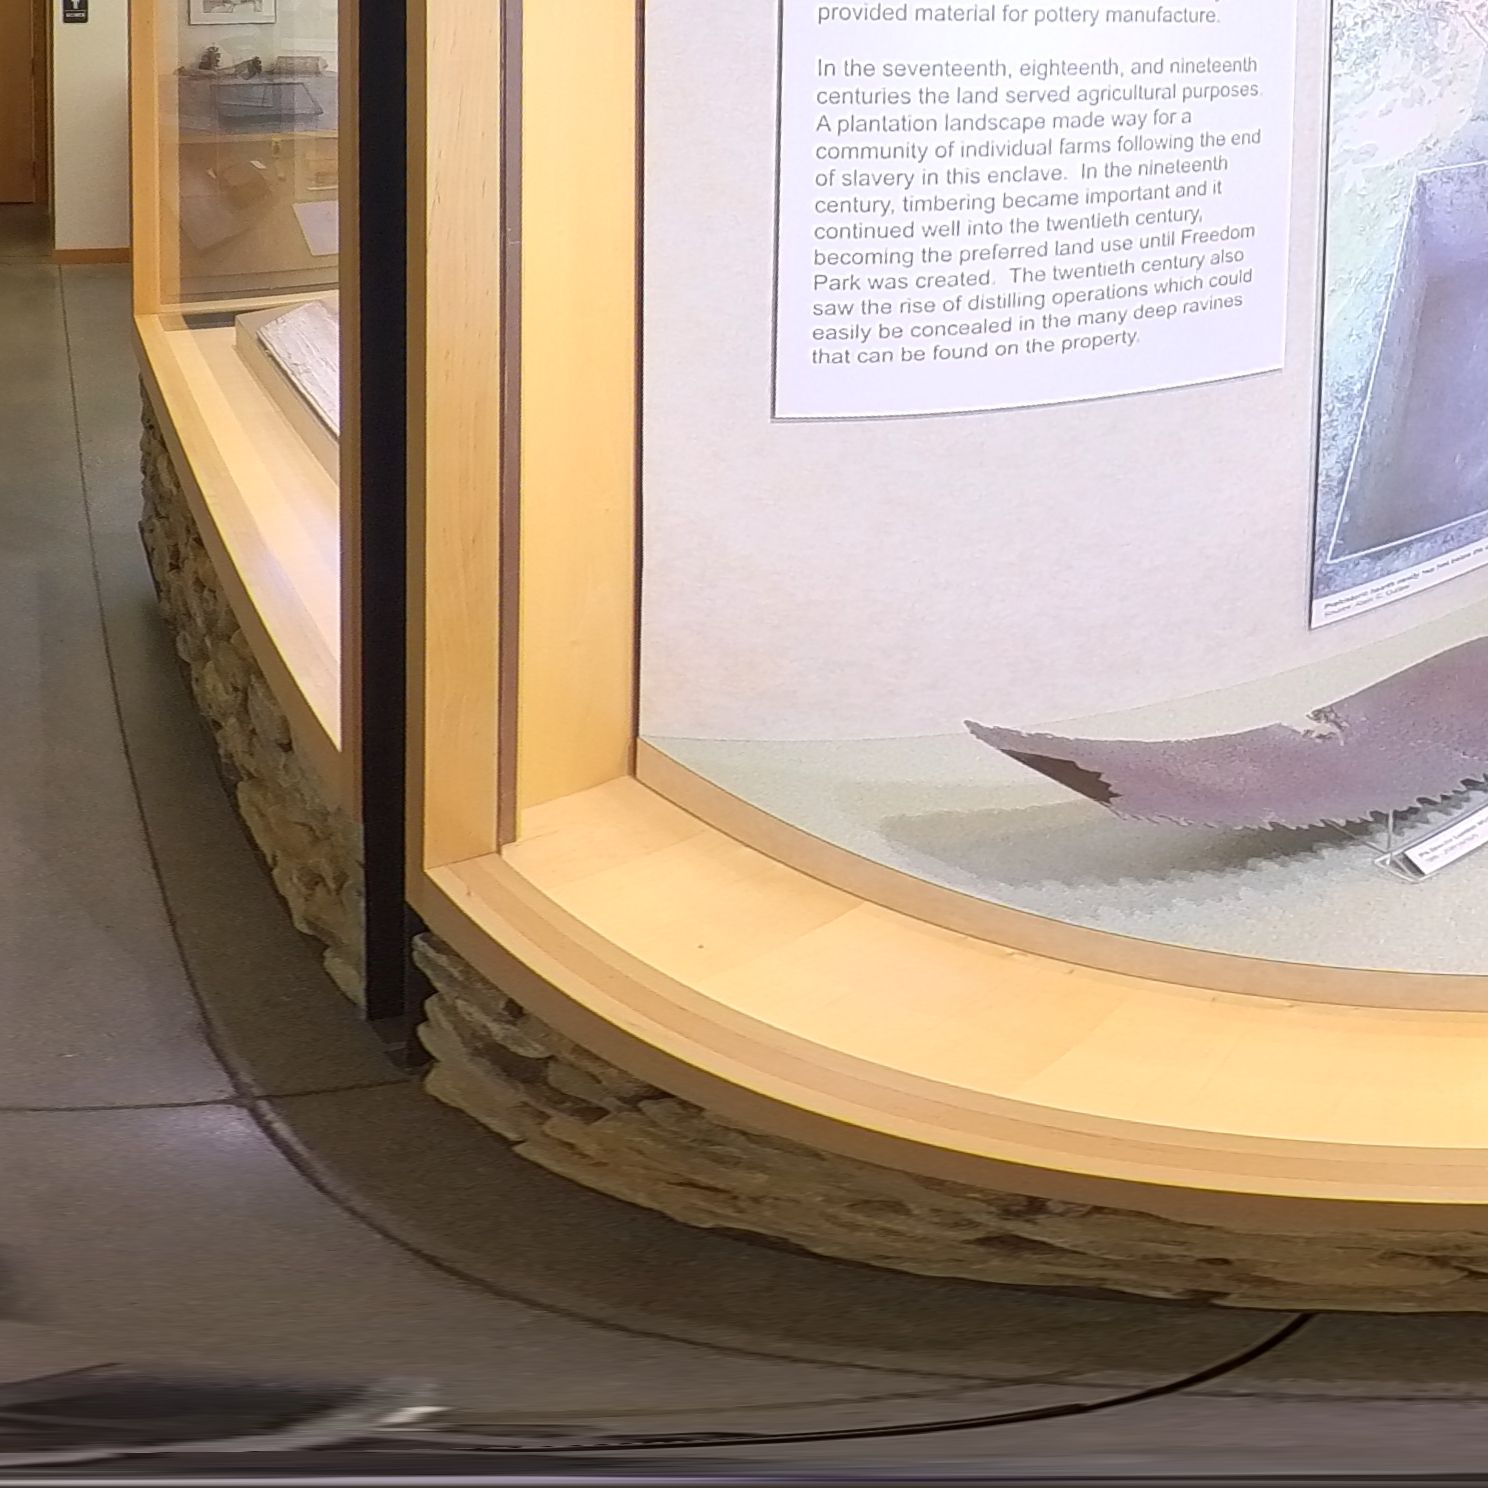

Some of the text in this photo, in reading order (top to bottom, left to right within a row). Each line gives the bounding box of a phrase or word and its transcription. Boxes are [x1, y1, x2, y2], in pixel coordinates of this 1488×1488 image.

[818, 56, 1257, 81] In the seventeenth, eighteenth, and nineteenth
[816, 83, 1263, 106] centuries the land served agricultural purposes.
[815, 108, 1192, 137] A plantation landscape made way for a
[815, 154, 1228, 191] of slavery in this enclave. In the nineteenth
[814, 179, 1222, 218] century, timbering became important and it
[814, 225, 1256, 269] becoming the preferred land use until Freedom
[812, 268, 1252, 316] saw the rise of distilling operations which could
[812, 294, 1243, 344] easily be concealed in the many deep ravines
[812, 330, 1140, 364] that can be found on the property.
